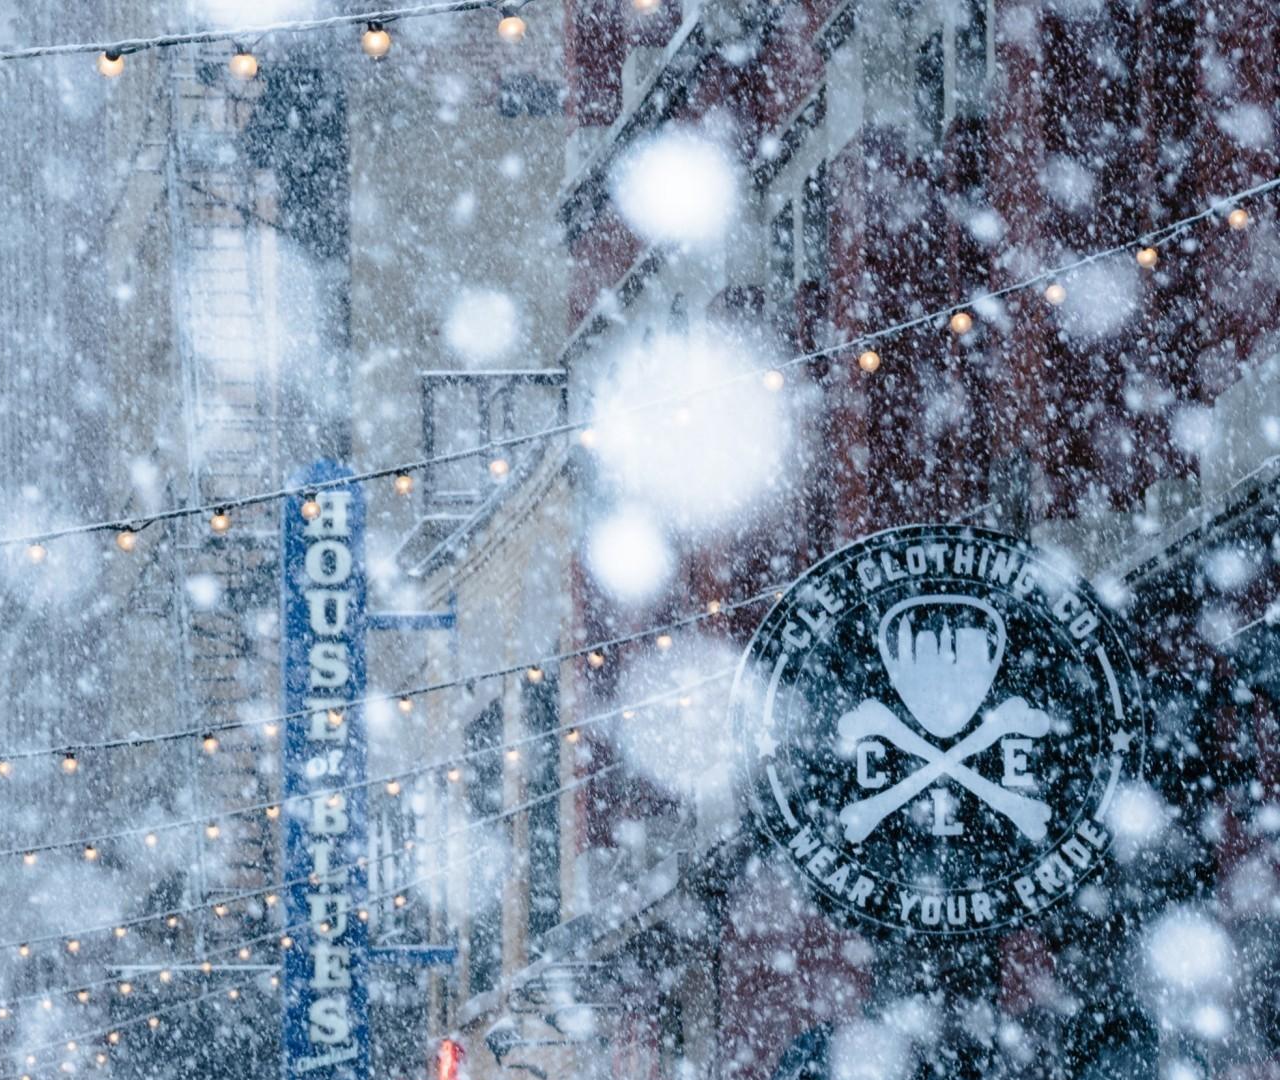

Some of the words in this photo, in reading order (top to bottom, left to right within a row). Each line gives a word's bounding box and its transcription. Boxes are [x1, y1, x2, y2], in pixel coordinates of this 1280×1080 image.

[303, 490, 353, 742] HOUSE
[783, 583, 844, 649] CLE
[856, 542, 1042, 594] CLOTHING
[306, 795, 353, 1044] BLUES
[786, 824, 876, 908] WEAR
[897, 891, 998, 927] YOUR
[1013, 818, 1110, 904] PRIDE
